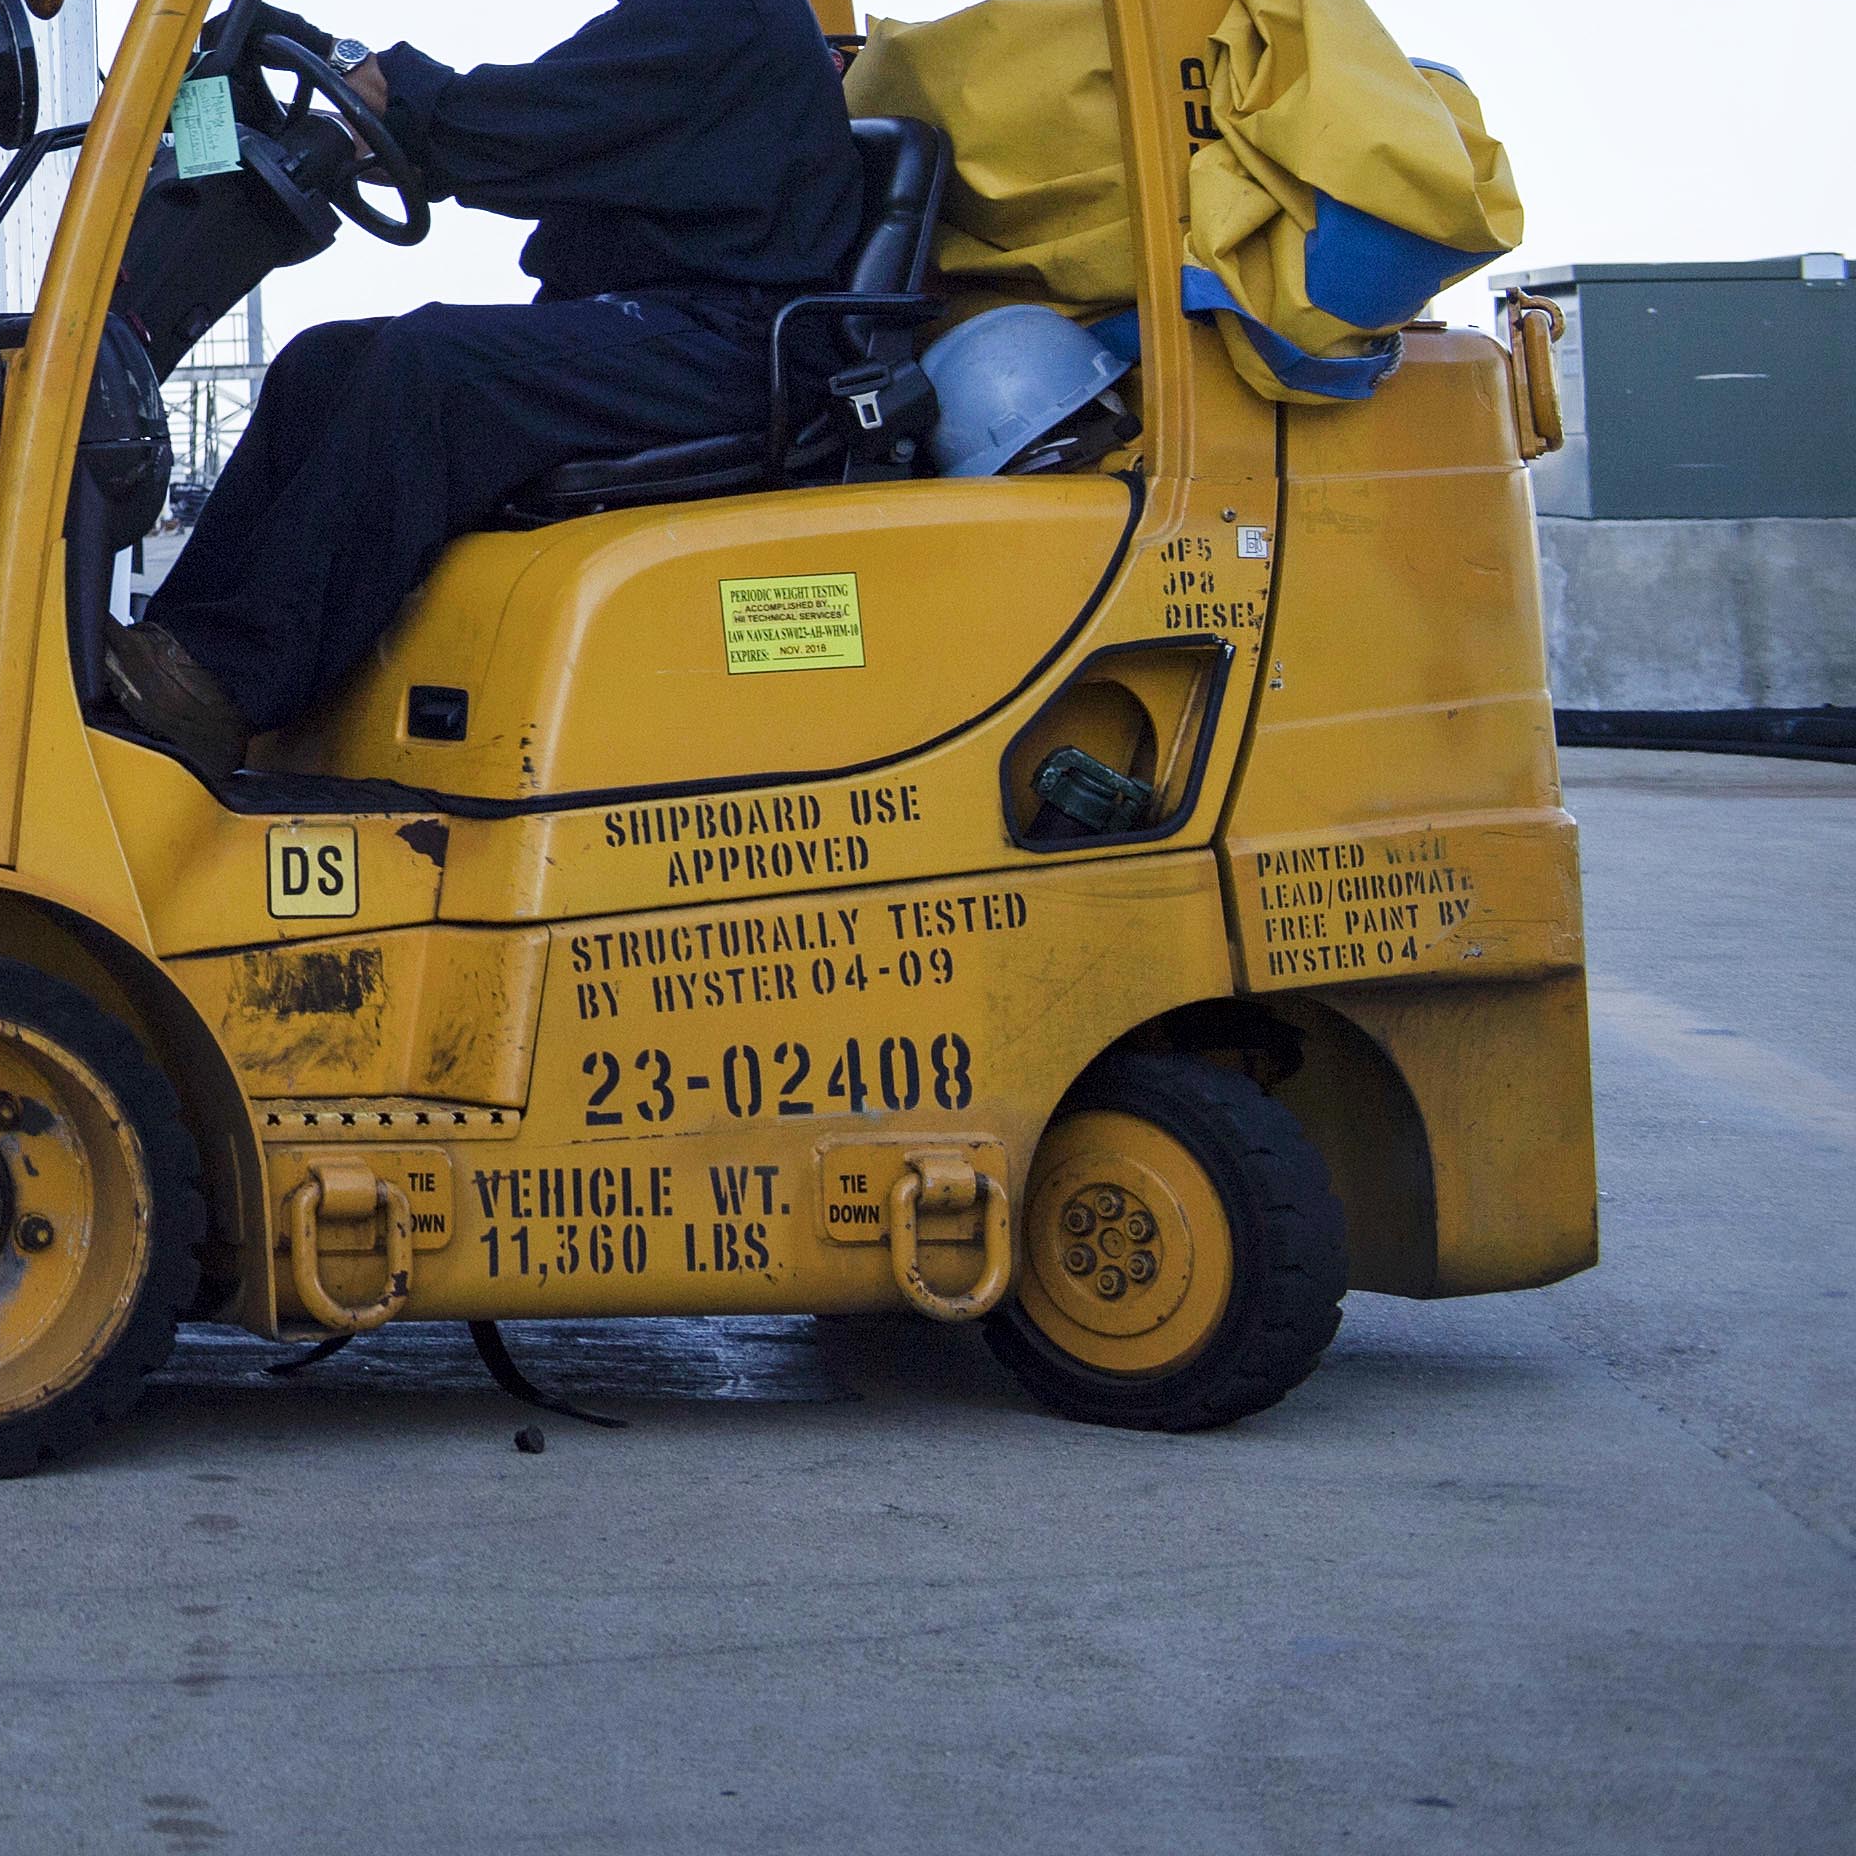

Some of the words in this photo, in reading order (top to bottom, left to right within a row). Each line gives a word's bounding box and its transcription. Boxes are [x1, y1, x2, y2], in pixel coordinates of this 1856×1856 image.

[730, 588, 772, 603] PERIODIC
[773, 586, 810, 601] WEIGHT
[811, 584, 848, 598] TESTING
[745, 601, 814, 612] ACCOMPLISHED
[816, 600, 827, 608] BY
[748, 613, 796, 623] TECHNICAL
[799, 610, 842, 620] SERVICES
[1165, 602, 1257, 629] DIESEL
[747, 628, 779, 642] NAVSEA
[605, 794, 821, 847] SHIPBOARD
[849, 785, 921, 826] USE
[282, 845, 344, 896] DS
[668, 835, 870, 888] APPROVED
[1257, 844, 1365, 877] PAINTED
[570, 908, 860, 973] STRUCTURALLY
[888, 892, 1027, 939] TESTED
[1265, 913, 1327, 943] FREE
[1345, 904, 1419, 935] PAINT
[1439, 898, 1470, 926] BY
[1269, 943, 1366, 976] HYSTER
[577, 980, 621, 1020] BY
[652, 964, 797, 1013] HYSTER
[582, 1032, 973, 1126] 23-02408
[408, 1173, 436, 1192] TIE
[474, 1167, 674, 1218] VEHICLE
[709, 1165, 791, 1216] WT.
[840, 1174, 867, 1193] TIE
[830, 1204, 880, 1224] DOWN
[480, 1222, 648, 1287] 11,360
